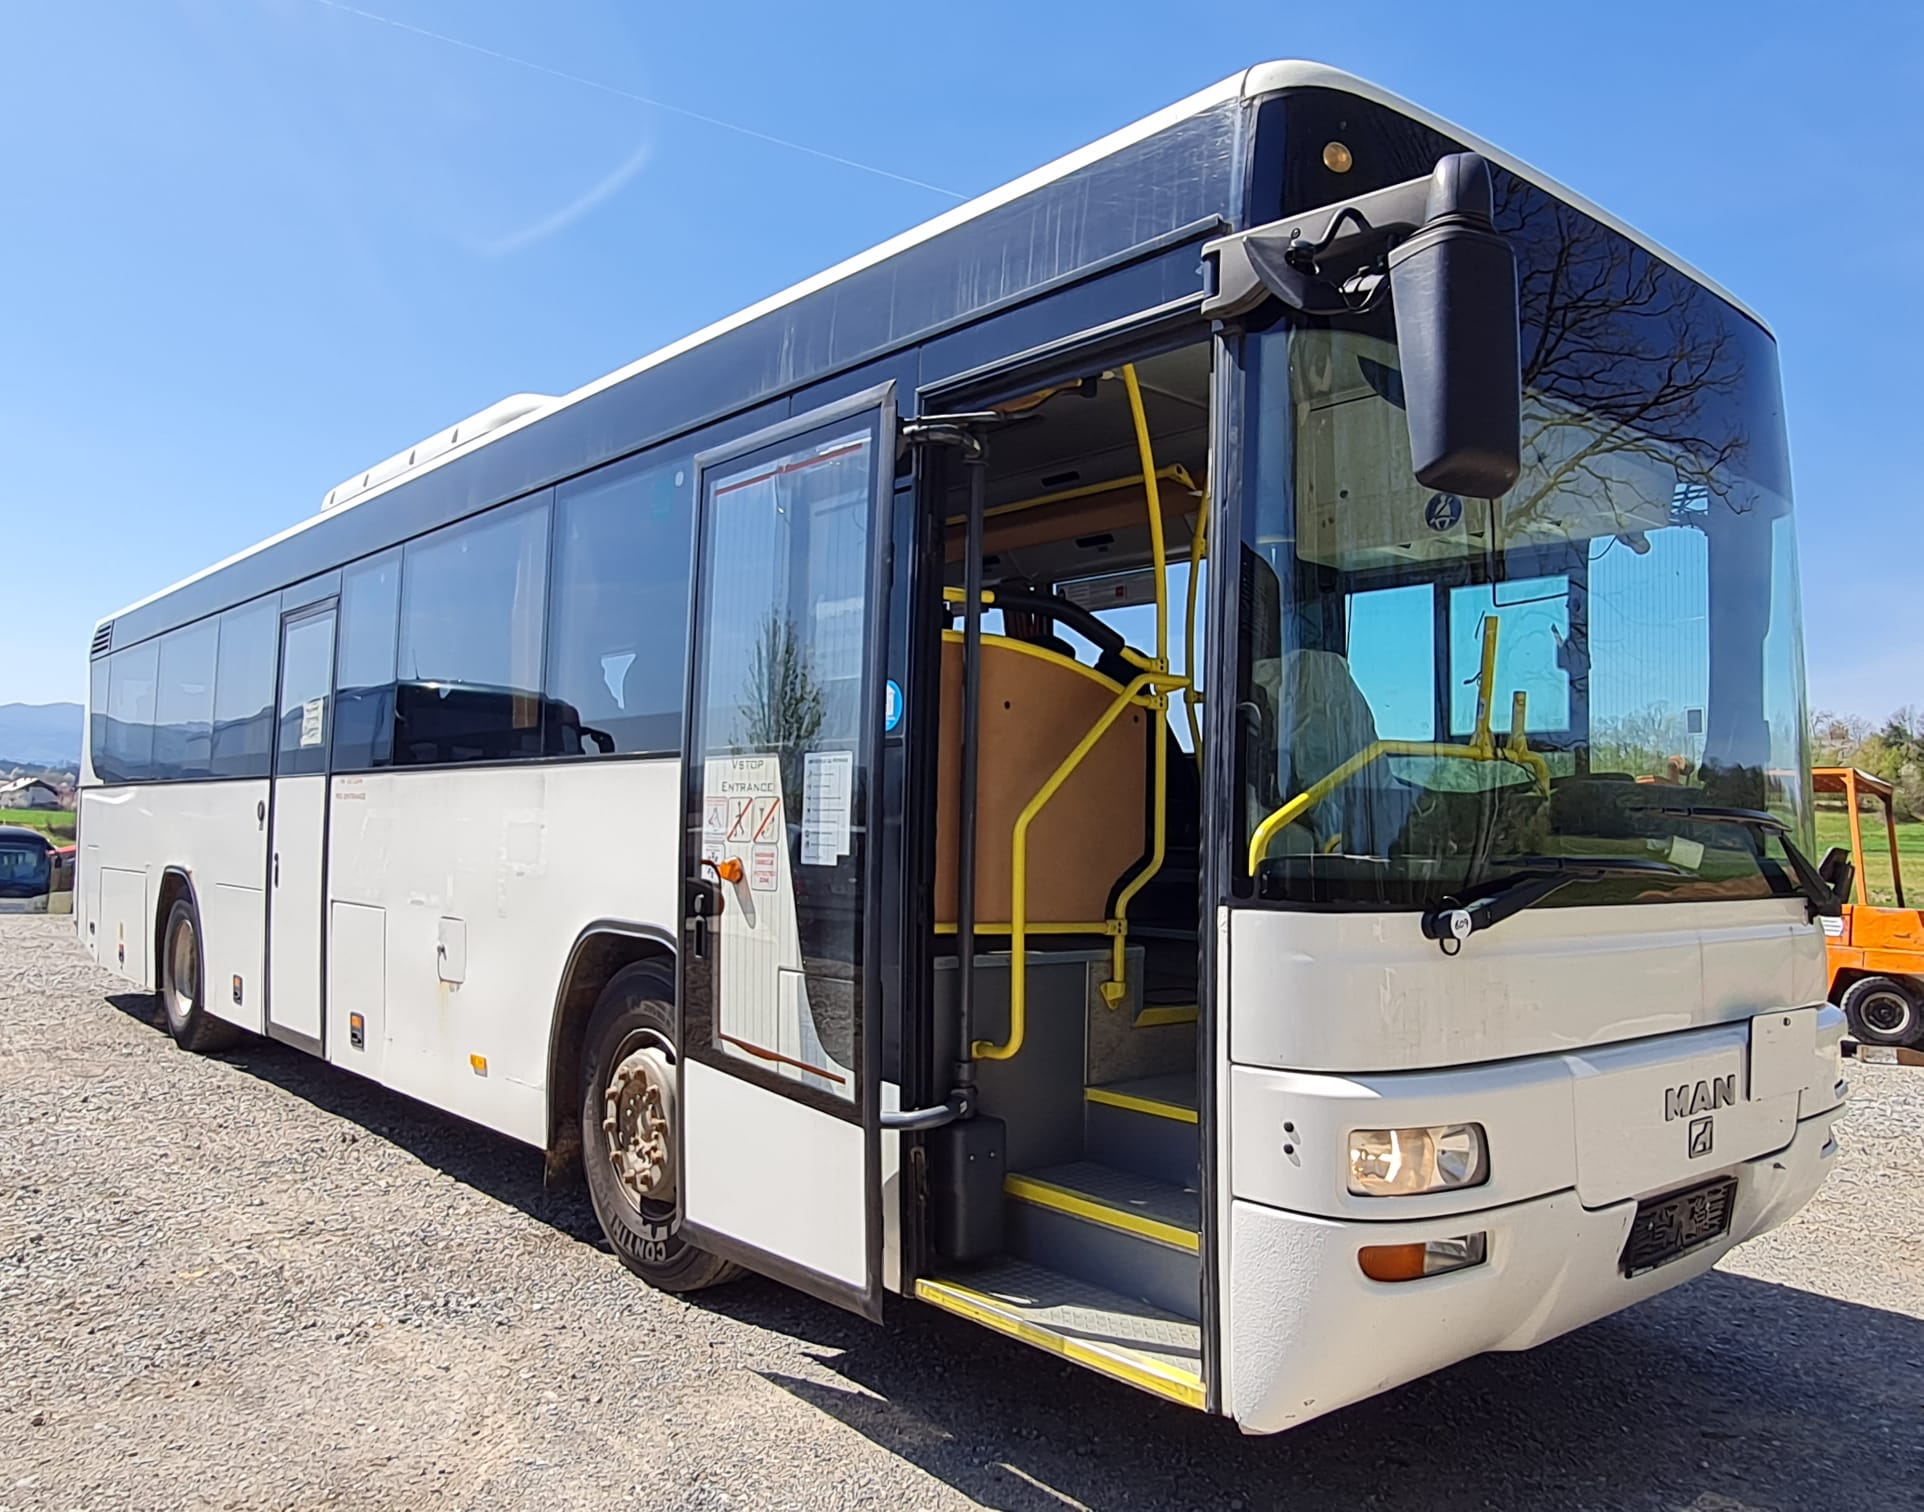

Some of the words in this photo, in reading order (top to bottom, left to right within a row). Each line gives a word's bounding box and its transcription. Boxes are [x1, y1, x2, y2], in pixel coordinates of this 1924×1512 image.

[731, 760, 765, 771] VSTOP
[721, 781, 774, 792] ENTRANCE
[1664, 1074, 1736, 1121] MAN
